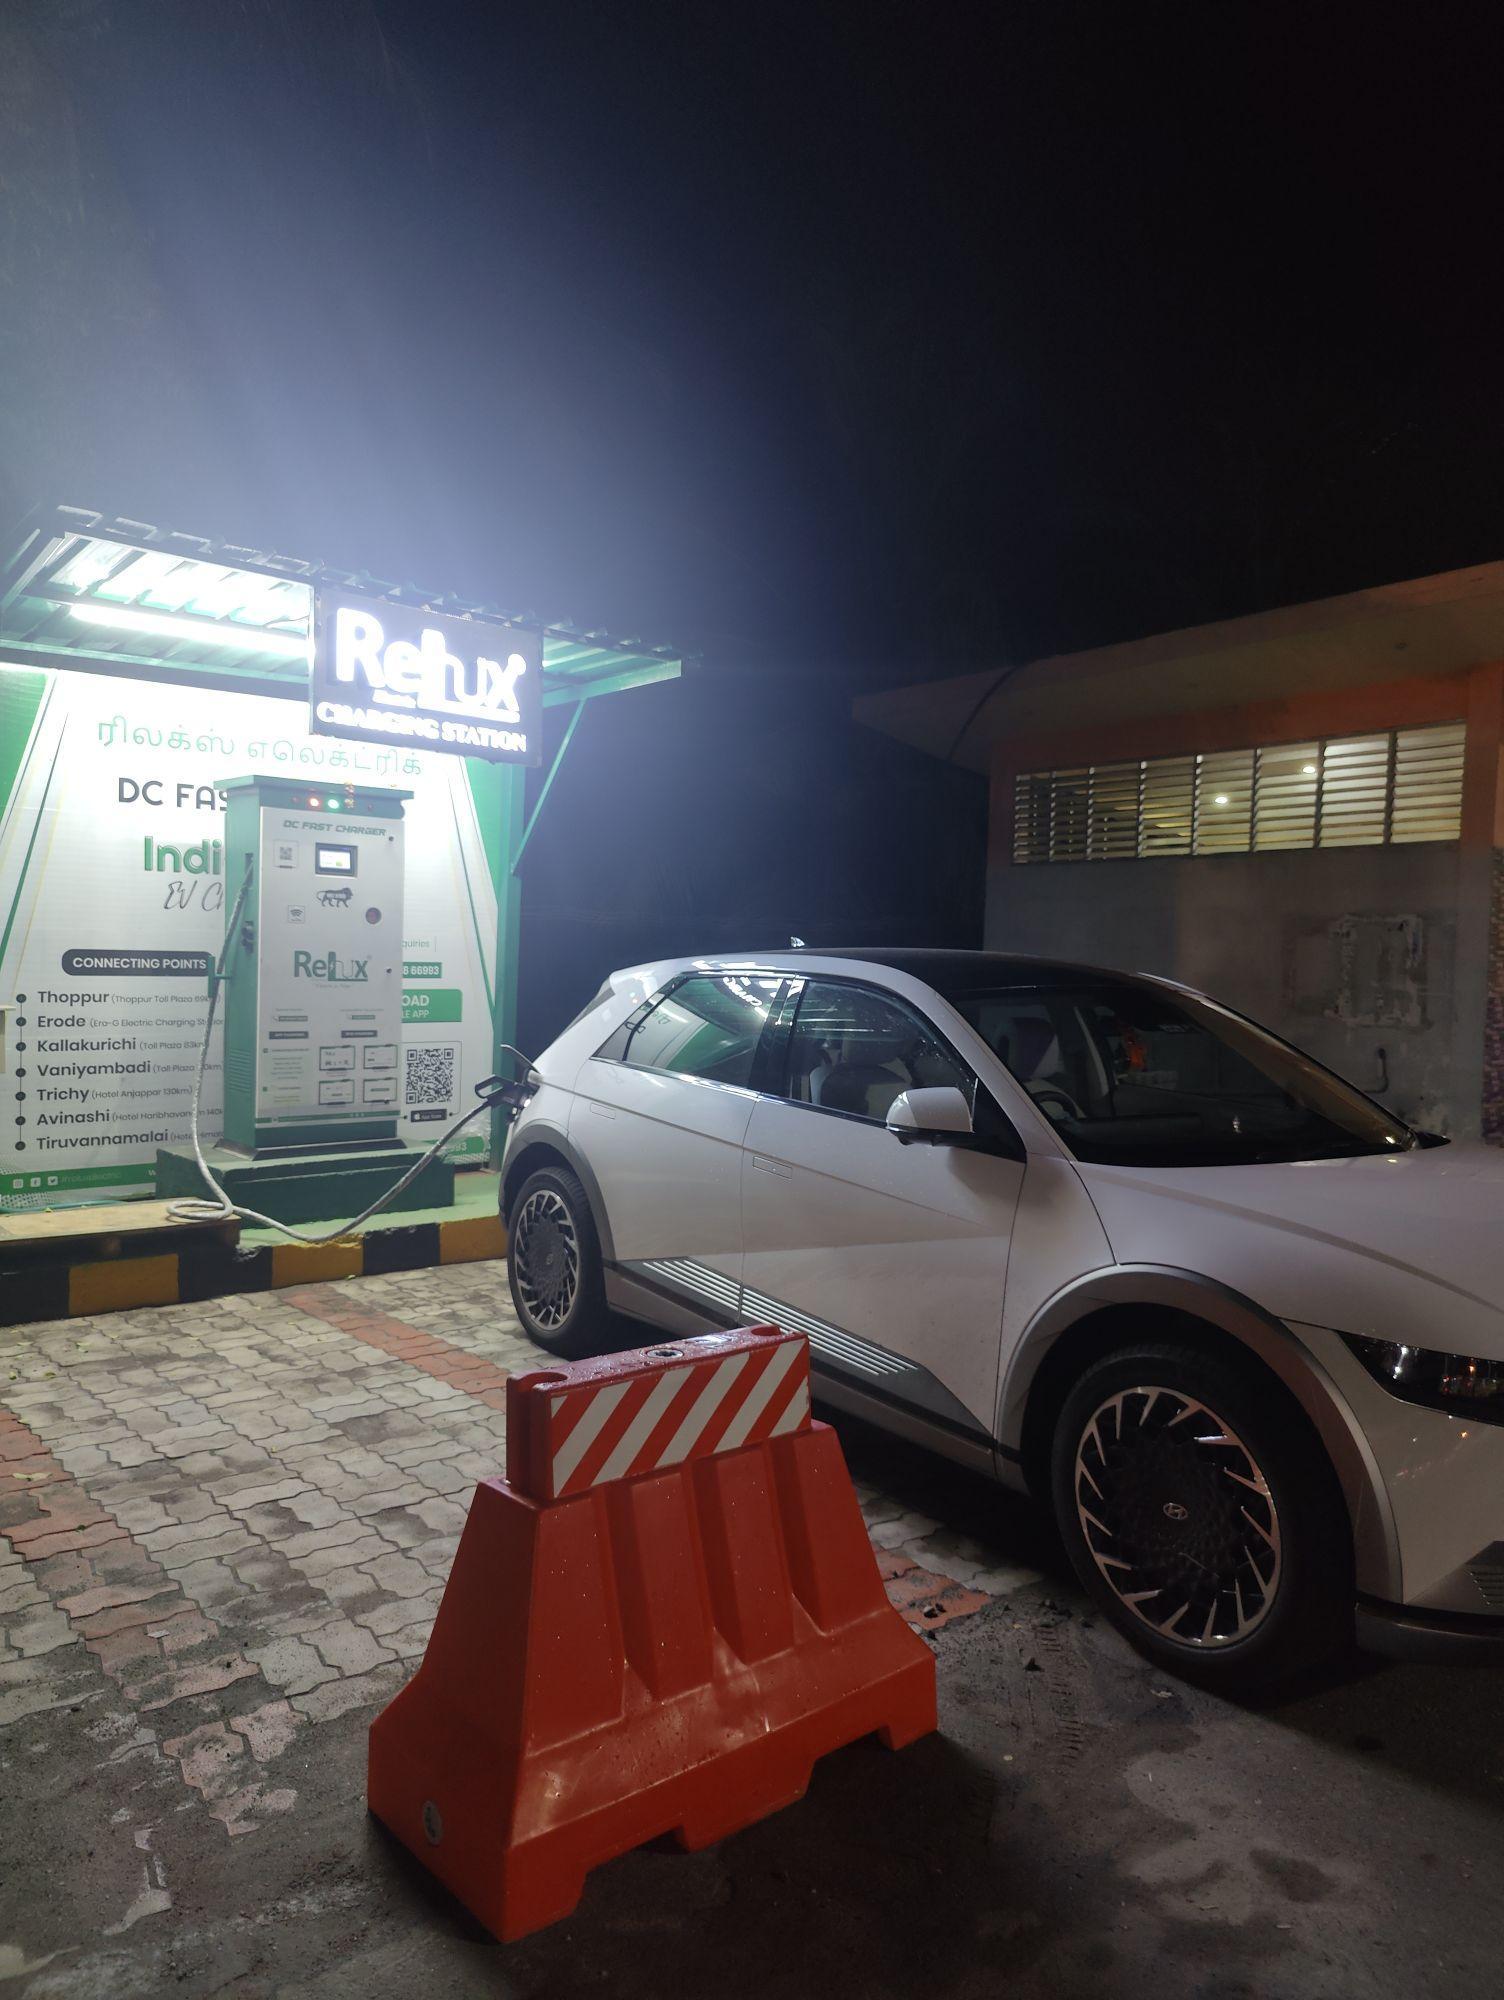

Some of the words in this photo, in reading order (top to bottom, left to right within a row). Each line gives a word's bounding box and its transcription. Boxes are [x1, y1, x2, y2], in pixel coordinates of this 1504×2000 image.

[97, 714, 235, 755] ரிலக்ஸ்
[317, 702, 439, 739] CHARGING
[442, 722, 526, 752] STATION
[119, 777, 163, 806] DC
[283, 820, 300, 829] DC
[302, 822, 333, 832] FAST
[336, 825, 386, 836] CHARGER
[144, 836, 222, 875] Indi
[163, 880, 198, 910] EV
[72, 957, 160, 969] CONNECTING
[162, 958, 207, 969] POINTS
[38, 991, 110, 1006] Thoppur
[111, 994, 152, 1004] (Thoppur
[154, 995, 168, 1003] Toll
[171, 995, 193, 1003] Plaza
[38, 1015, 86, 1028] Erode
[121, 1018, 153, 1027] Electric
[155, 1018, 195, 1028] Charging
[412, 1009, 430, 1018] APP
[38, 1038, 136, 1052] Kallakurichi
[139, 1040, 157, 1050] (Toll
[160, 1041, 182, 1049] Plaza
[37, 1060, 151, 1079] Vaniyambadi
[152, 1064, 172, 1073] (Toll
[173, 1064, 195, 1072] Plaza
[37, 1087, 90, 1103] Trichy
[91, 1089, 119, 1100] (Hotel
[121, 1088, 161, 1098] Anjappar
[37, 1109, 110, 1126] Avinashi
[112, 1111, 139, 1121] (Hotel
[36, 1129, 169, 1150] Tiruvannamalai
